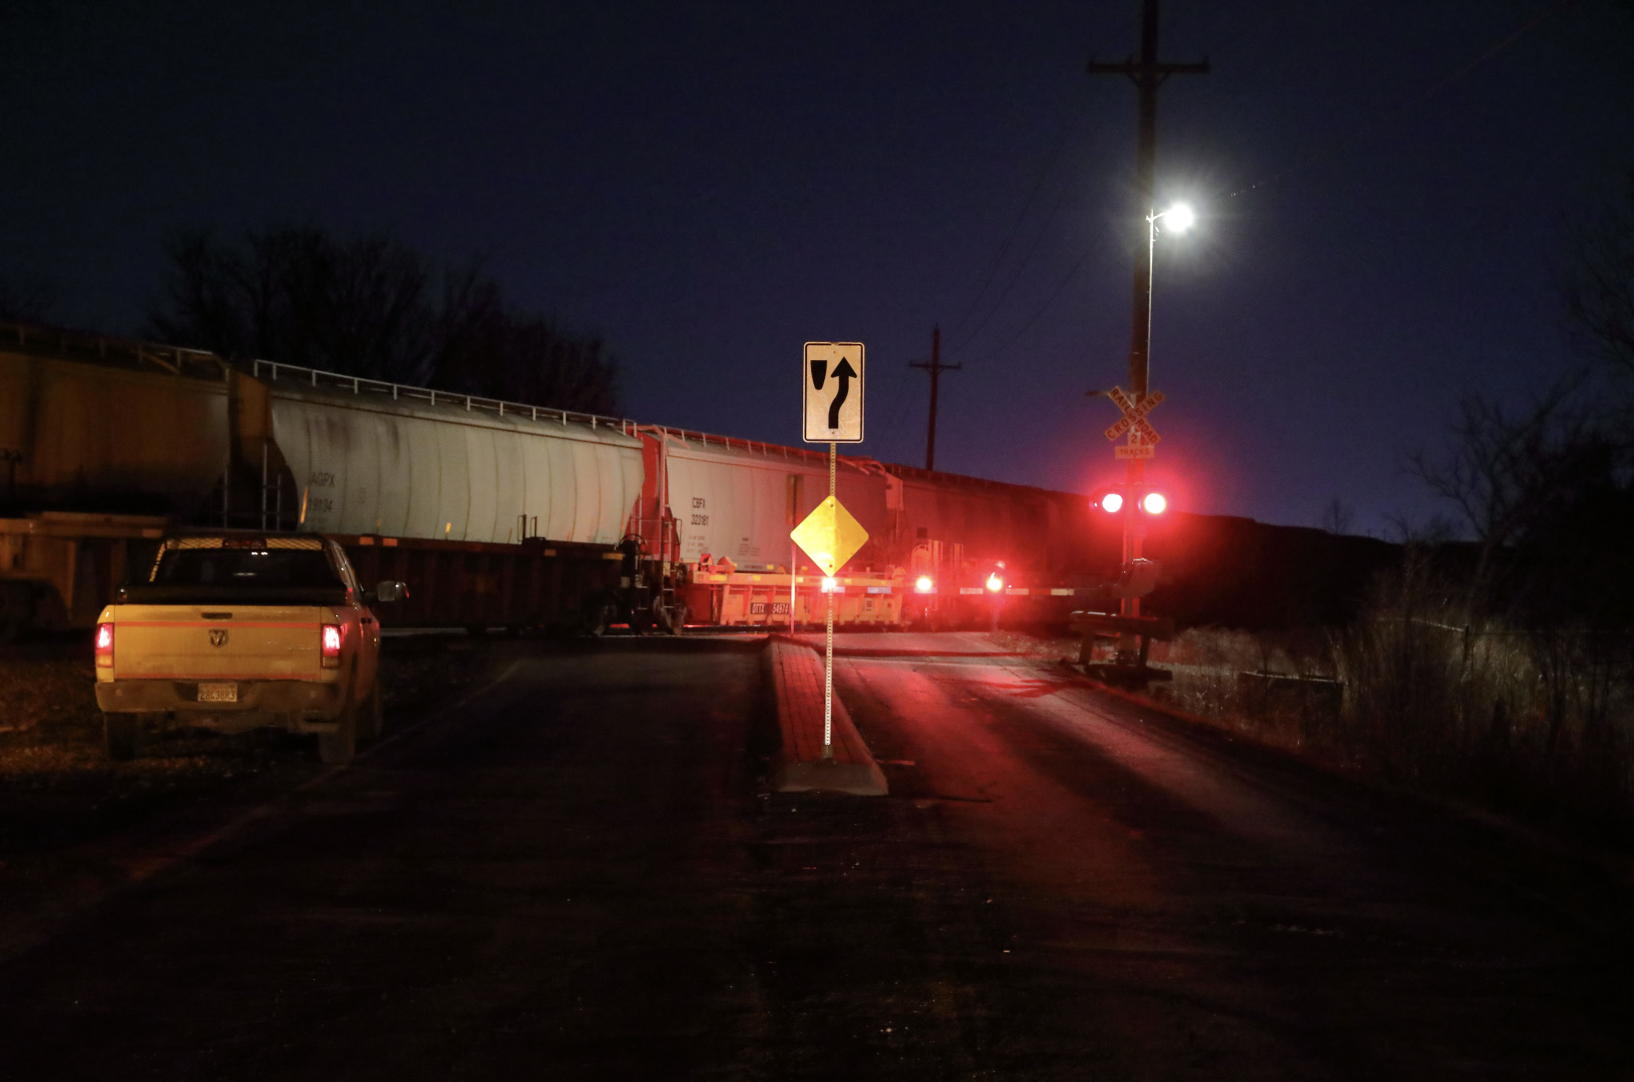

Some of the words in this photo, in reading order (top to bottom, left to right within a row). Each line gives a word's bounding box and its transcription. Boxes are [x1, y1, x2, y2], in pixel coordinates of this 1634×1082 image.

[1107, 391, 1163, 439] CROSSING
[1131, 434, 1137, 444] 2
[1119, 448, 1150, 456] TRACKS
